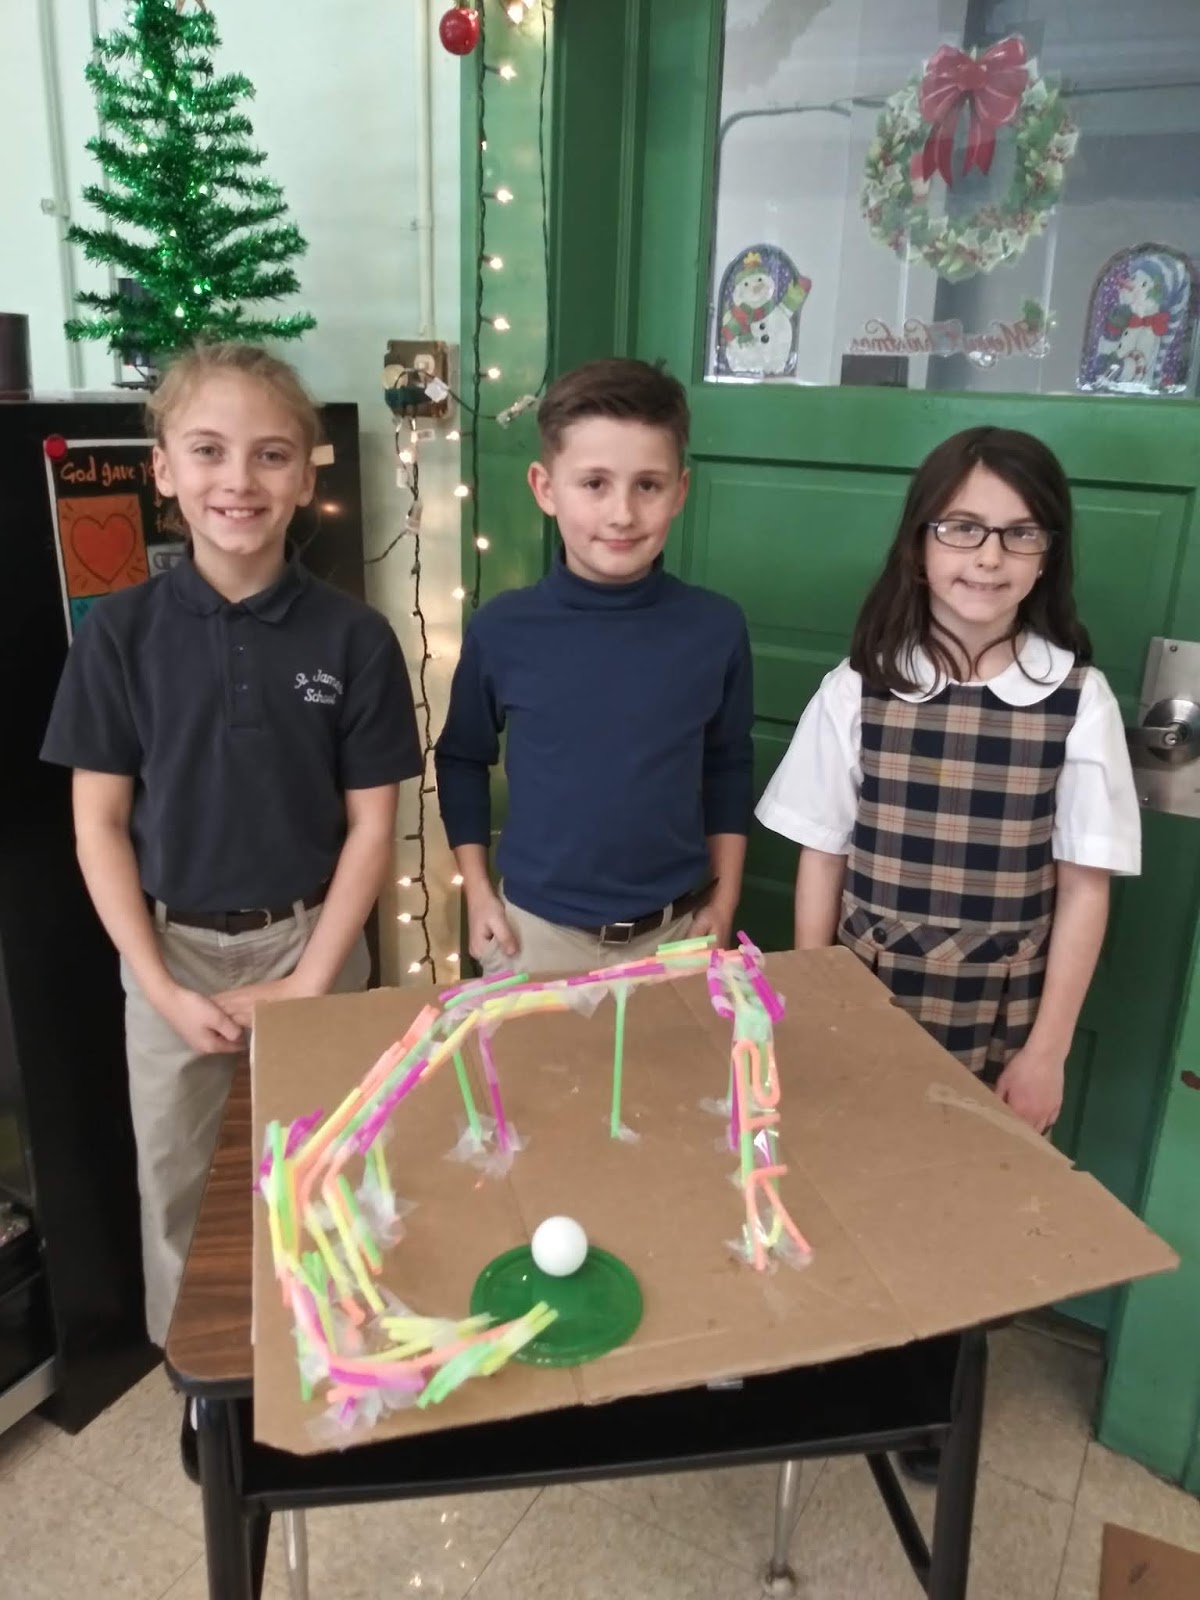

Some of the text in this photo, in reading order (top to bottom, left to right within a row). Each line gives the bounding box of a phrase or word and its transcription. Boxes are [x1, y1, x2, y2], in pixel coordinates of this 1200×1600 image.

[61, 455, 96, 484] God
[102, 462, 136, 487] gave
[312, 669, 343, 695] James
[304, 687, 336, 705] School
